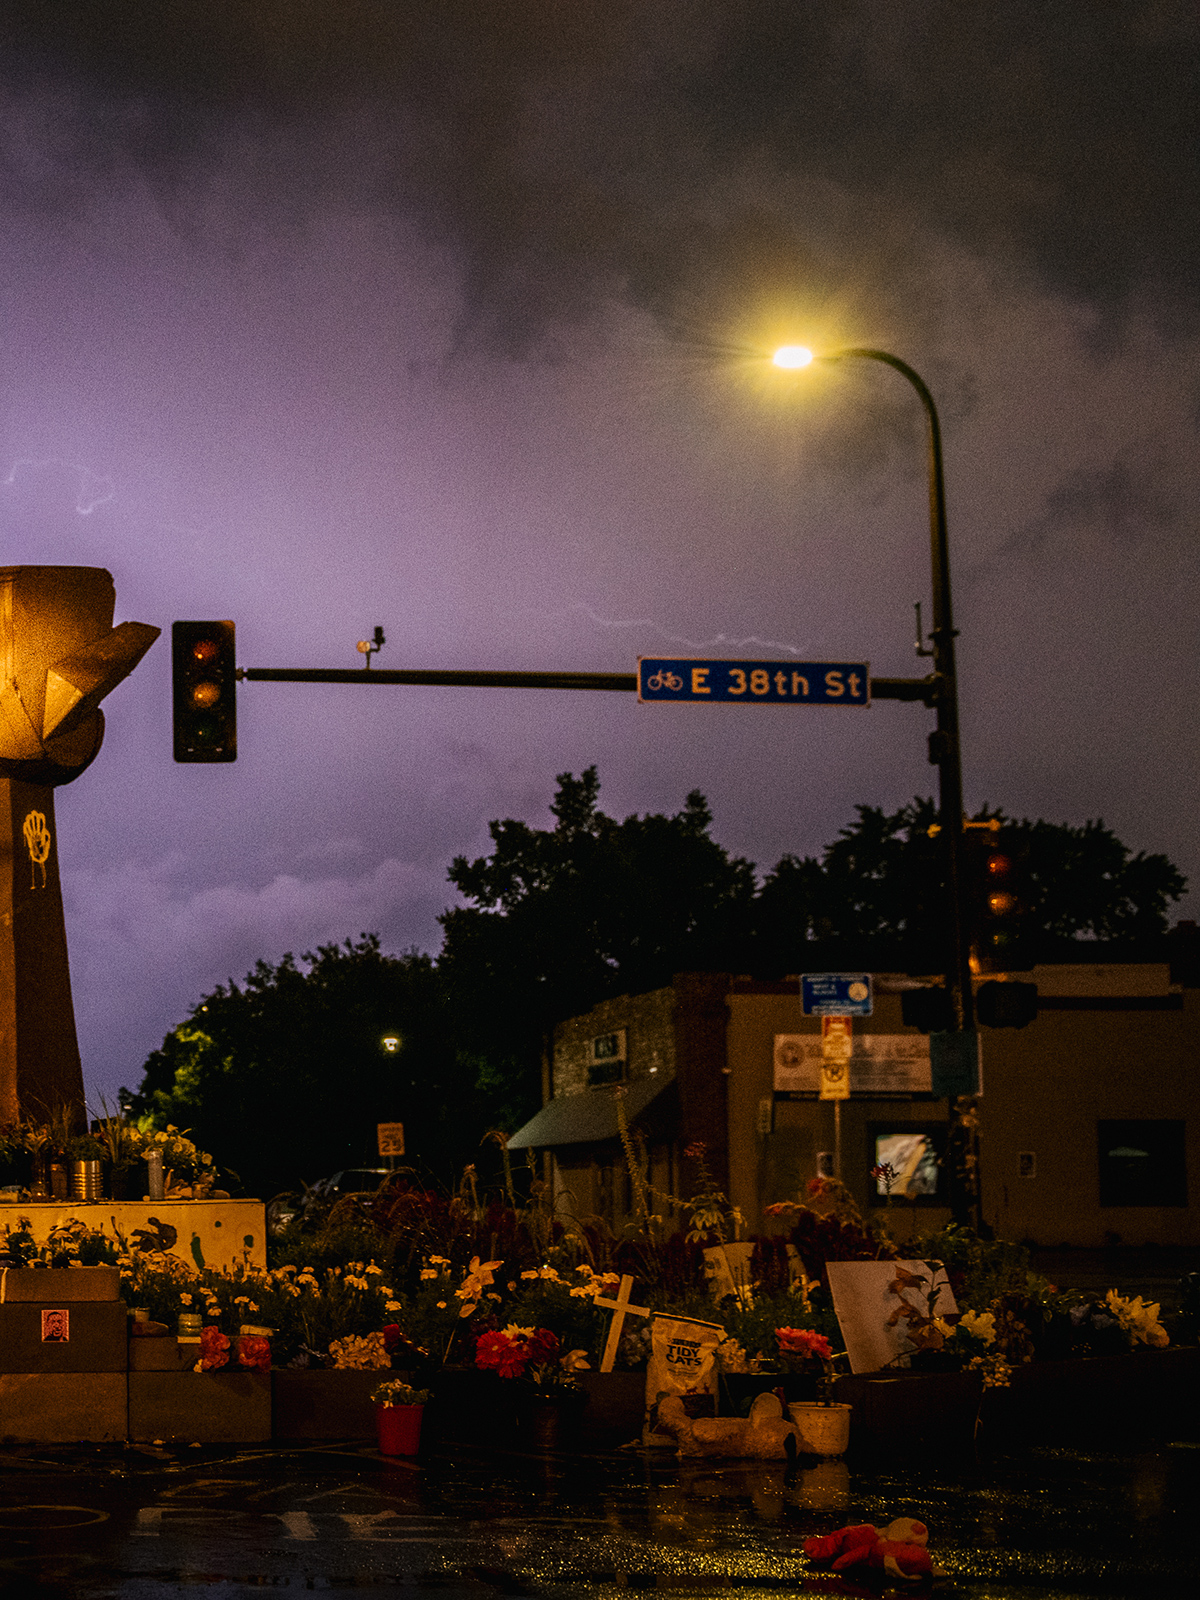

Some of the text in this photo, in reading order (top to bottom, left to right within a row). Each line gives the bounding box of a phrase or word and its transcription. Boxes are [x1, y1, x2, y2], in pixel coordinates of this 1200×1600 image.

[691, 667, 861, 698] E 38th St
[666, 1344, 700, 1357] TIDY
[666, 1353, 702, 1366] CATS
